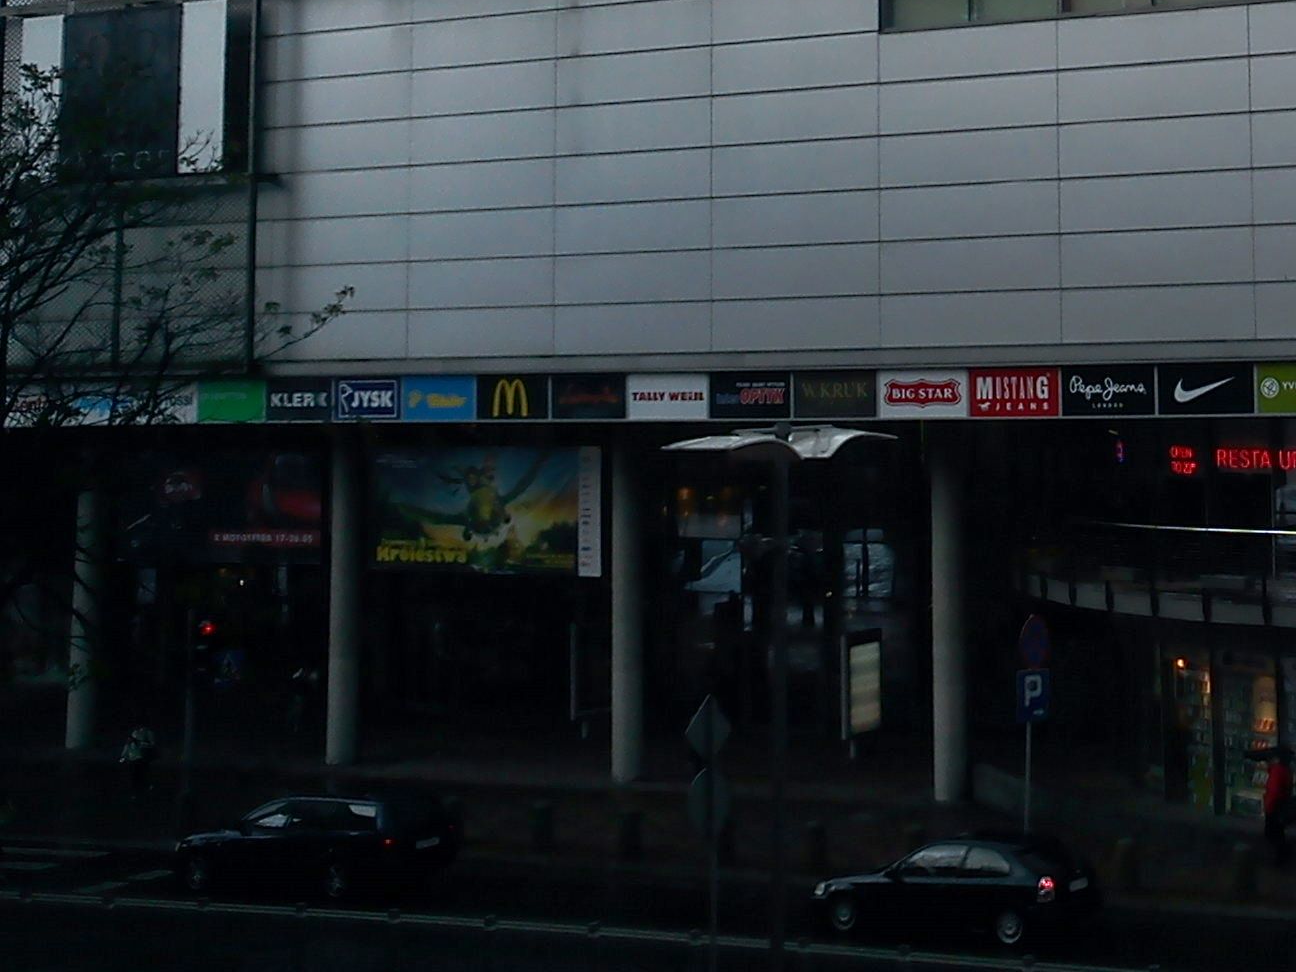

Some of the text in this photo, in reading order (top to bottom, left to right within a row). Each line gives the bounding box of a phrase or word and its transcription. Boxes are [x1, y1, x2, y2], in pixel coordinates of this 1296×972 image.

[891, 387, 954, 400] BIG STAR
[976, 375, 1050, 400] MUSTANG
[1069, 375, 1146, 401] Pepe Jeans
[270, 392, 315, 408] KLER
[351, 390, 394, 409] JYSK
[632, 392, 665, 401] TALLY
[995, 401, 1050, 411] JEANS
[1023, 673, 1043, 708] P
